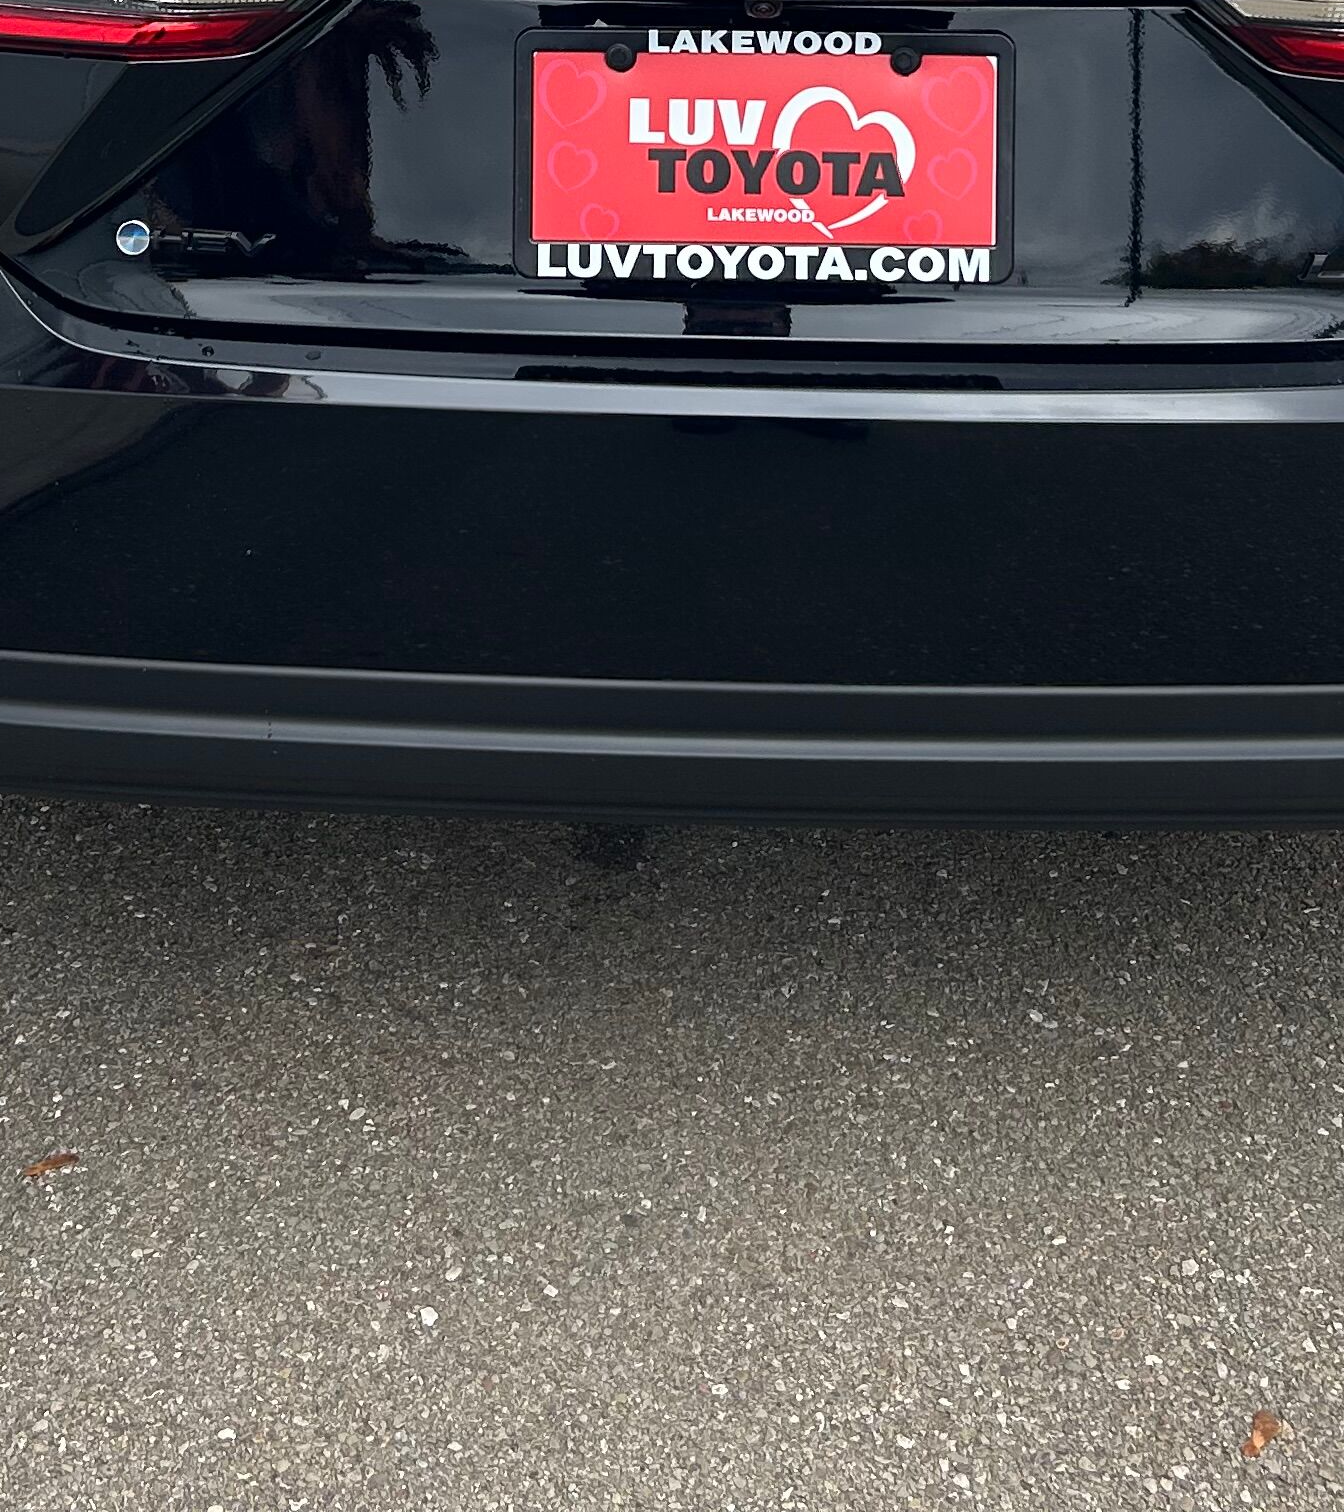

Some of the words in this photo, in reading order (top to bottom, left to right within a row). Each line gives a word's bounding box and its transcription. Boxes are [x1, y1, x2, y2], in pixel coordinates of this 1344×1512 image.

[648, 29, 883, 55] LAKEWOOD
[628, 98, 767, 145] LUV
[648, 148, 906, 197] TOYOTA
[707, 206, 816, 224] LAKEWOOD
[537, 243, 990, 283] LUVTOYOTA.COM
